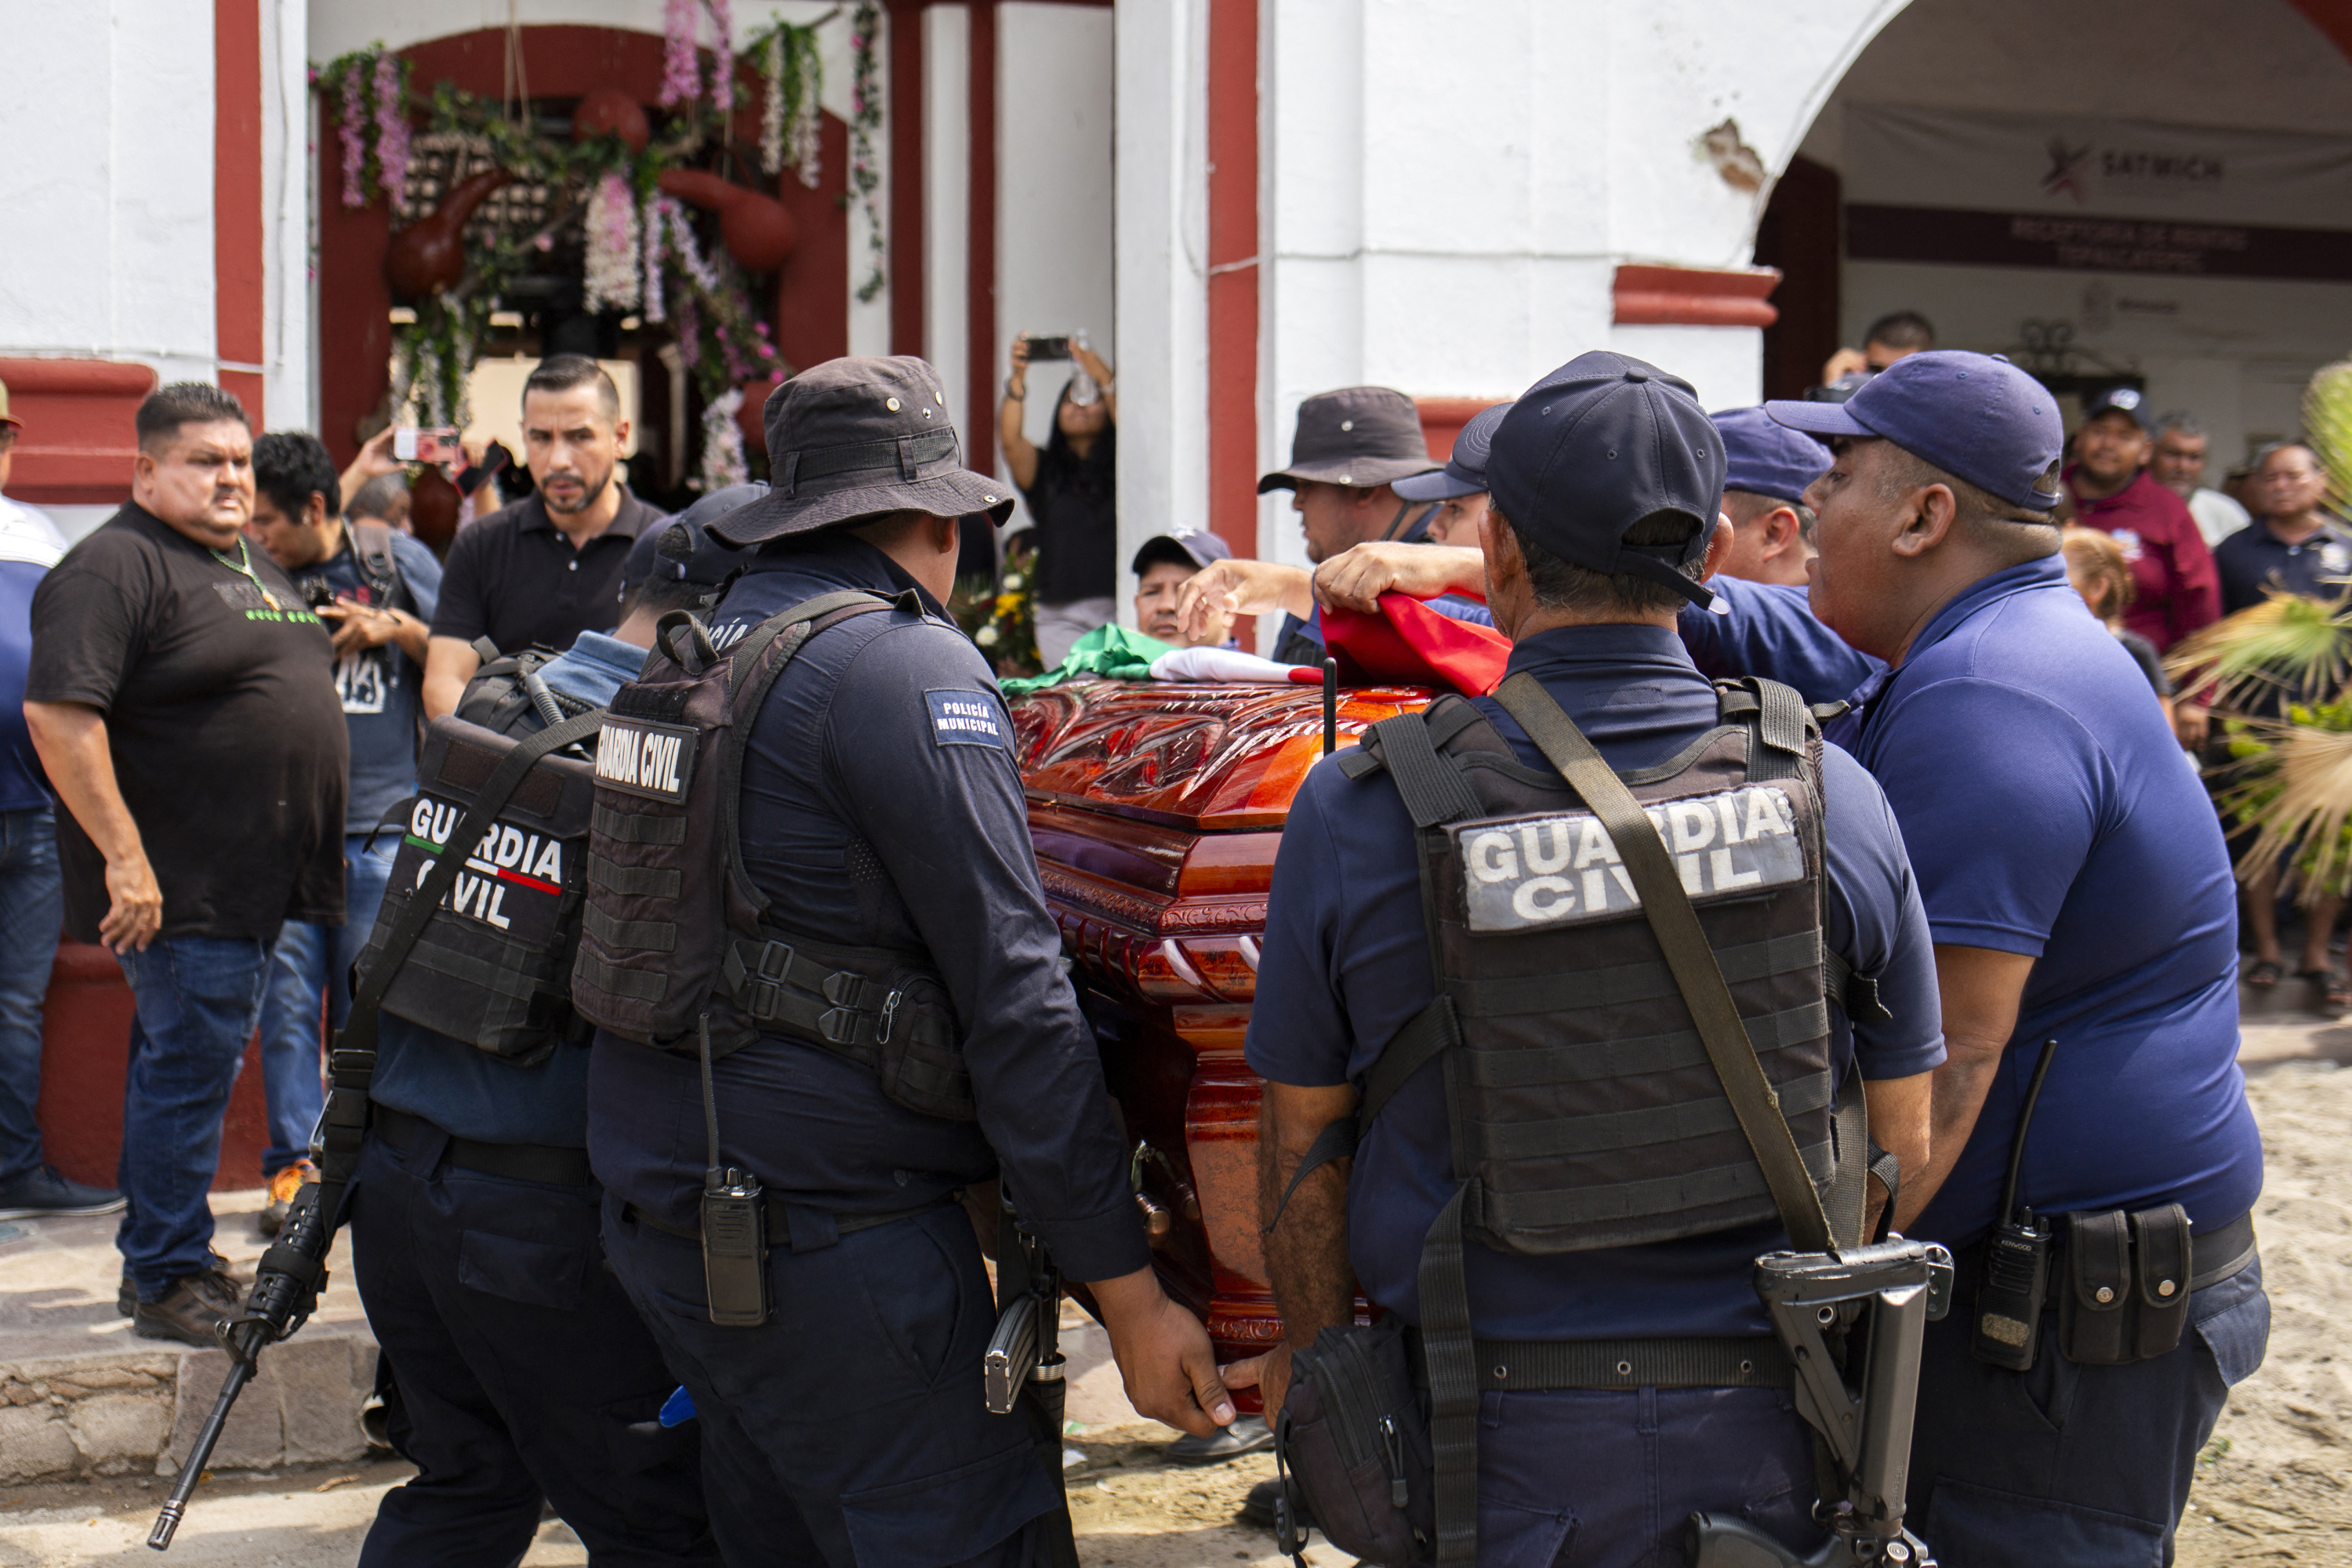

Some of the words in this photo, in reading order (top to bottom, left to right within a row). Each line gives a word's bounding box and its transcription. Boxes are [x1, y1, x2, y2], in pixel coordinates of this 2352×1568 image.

[937, 717, 999, 736] MUNICIPAL
[943, 702, 989, 719] POLICÍA
[596, 724, 640, 784] GUARDIA
[641, 732, 681, 793] CIVIL
[412, 798, 561, 884] GURDIA
[416, 859, 510, 930] VIL
[2001, 1240, 2032, 1251] KENWOOD
